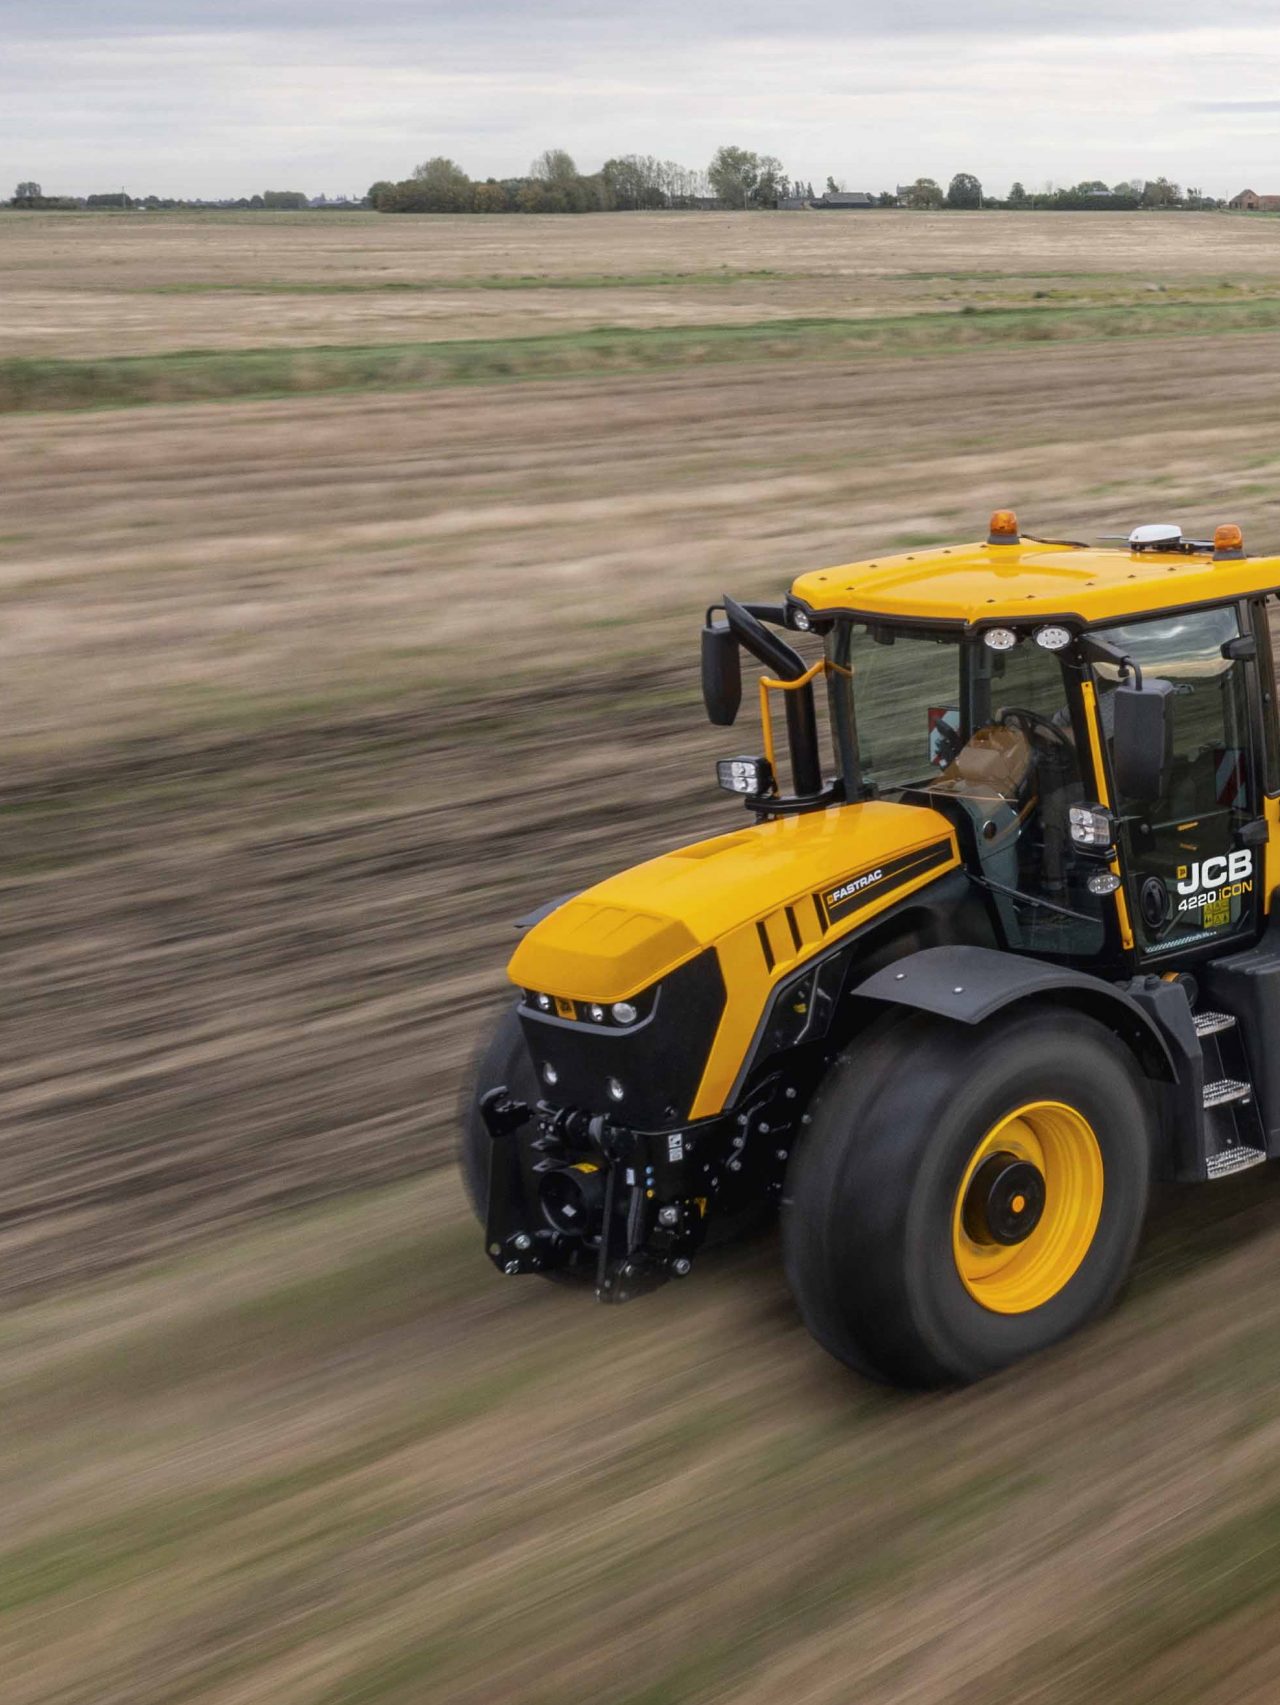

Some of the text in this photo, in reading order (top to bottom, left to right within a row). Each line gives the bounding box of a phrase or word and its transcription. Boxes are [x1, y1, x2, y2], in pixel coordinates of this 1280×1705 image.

[833, 870, 883, 902] FASTRAC
[1177, 849, 1253, 895] JCB
[1178, 880, 1253, 911] 4220 iCON
